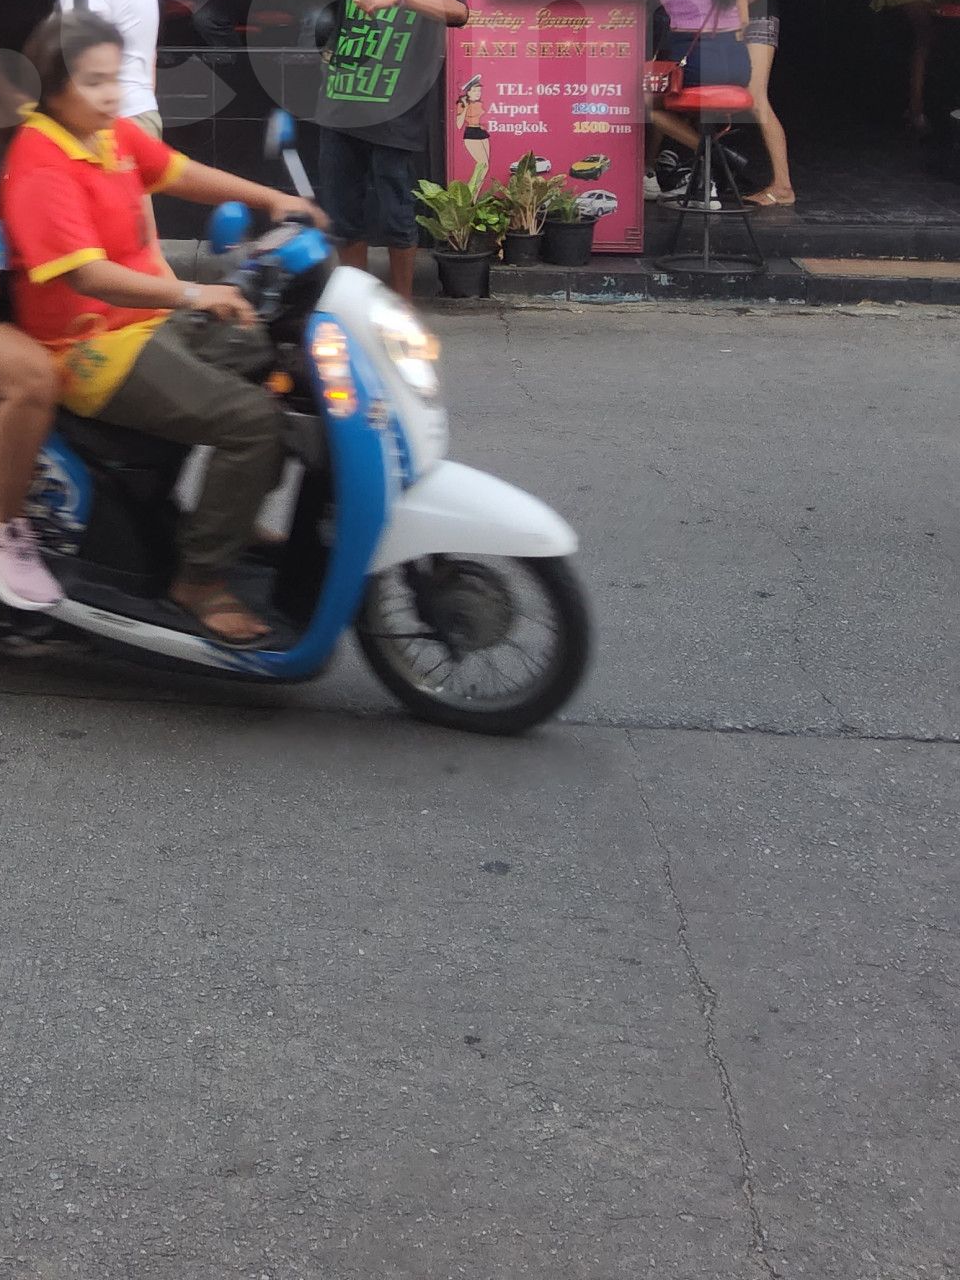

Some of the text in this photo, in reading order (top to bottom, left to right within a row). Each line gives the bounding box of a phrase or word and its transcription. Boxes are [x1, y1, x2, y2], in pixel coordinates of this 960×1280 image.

[460, 41, 632, 59] TAXI SERVICE
[496, 83, 623, 96] TEL: 065 329 0751
[488, 102, 539, 117] Airport
[488, 121, 548, 135] Bangkok
